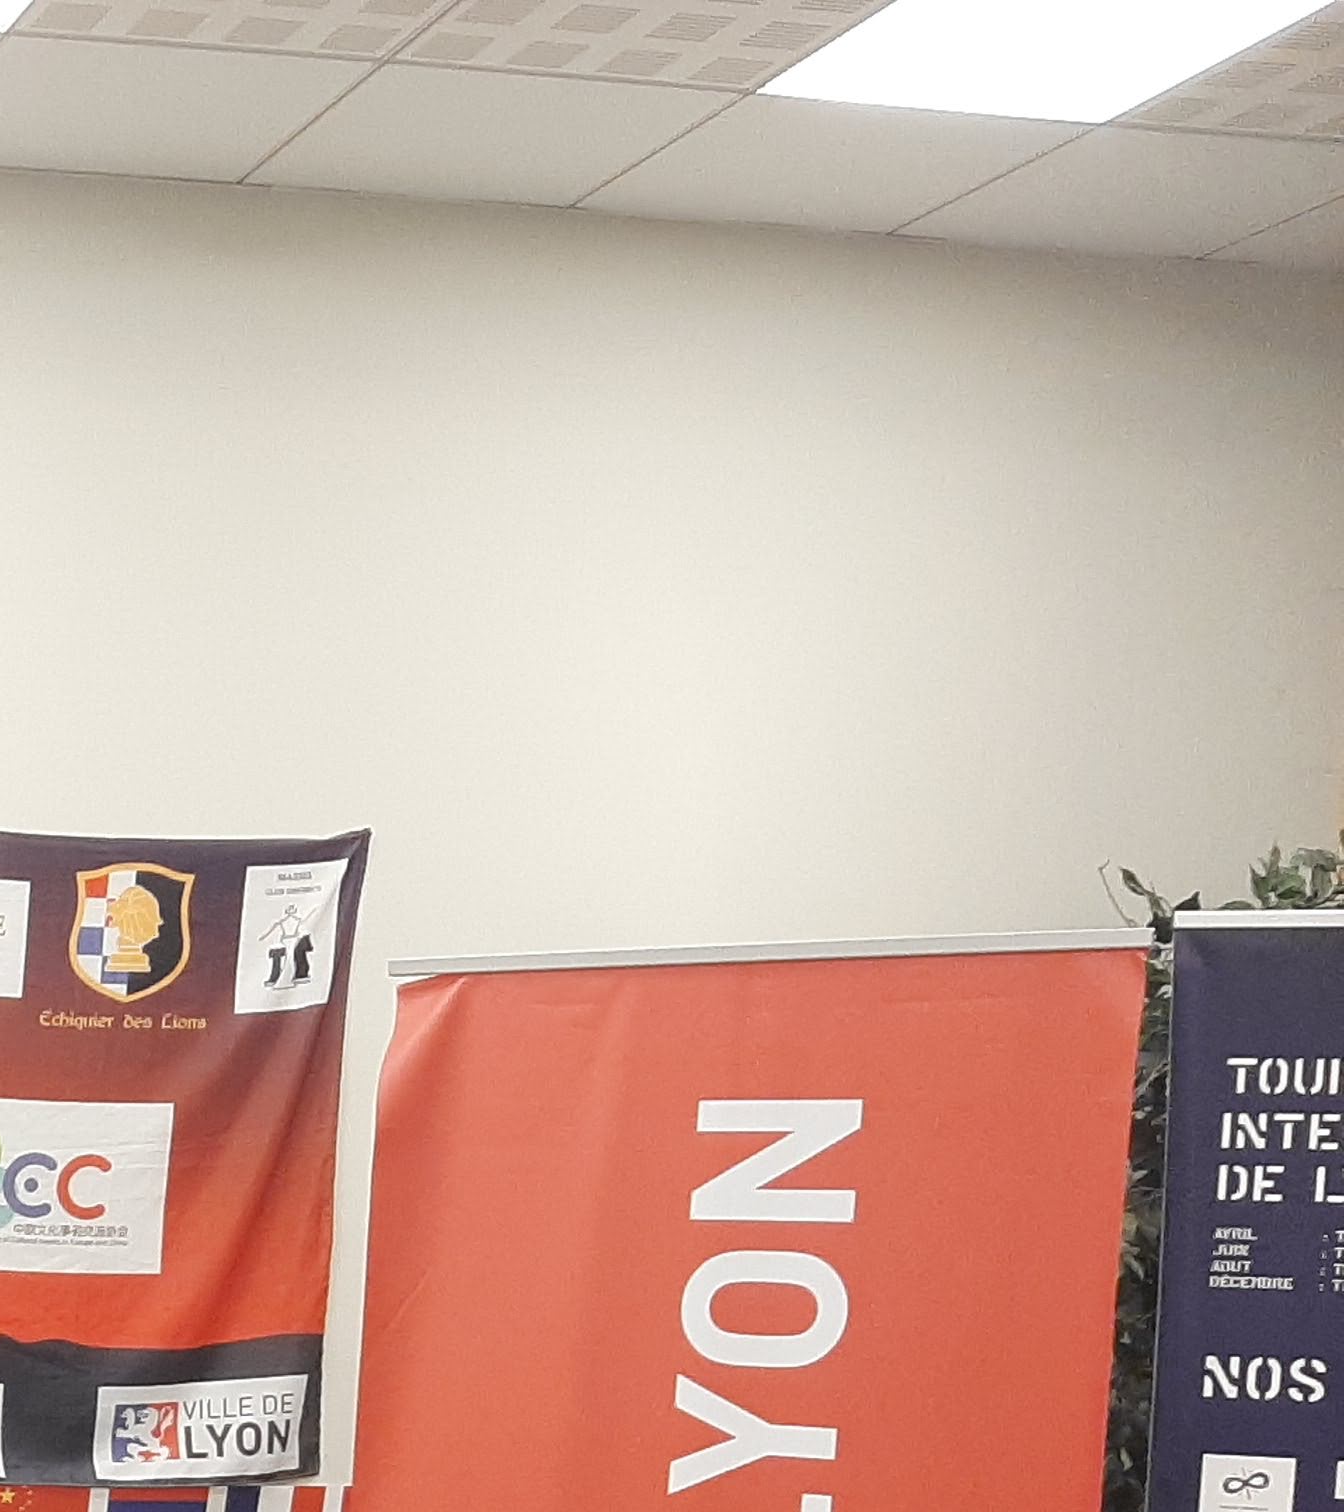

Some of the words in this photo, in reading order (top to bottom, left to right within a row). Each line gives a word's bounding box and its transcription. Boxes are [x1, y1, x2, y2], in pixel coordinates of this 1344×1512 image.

[1226, 1057, 1344, 1096] TOU
[1216, 1164, 1286, 1203] DE
[1201, 1355, 1328, 1403] NOS
[182, 1395, 254, 1420] VILLE
[262, 1392, 294, 1416] DE
[184, 1418, 292, 1459] LYON
